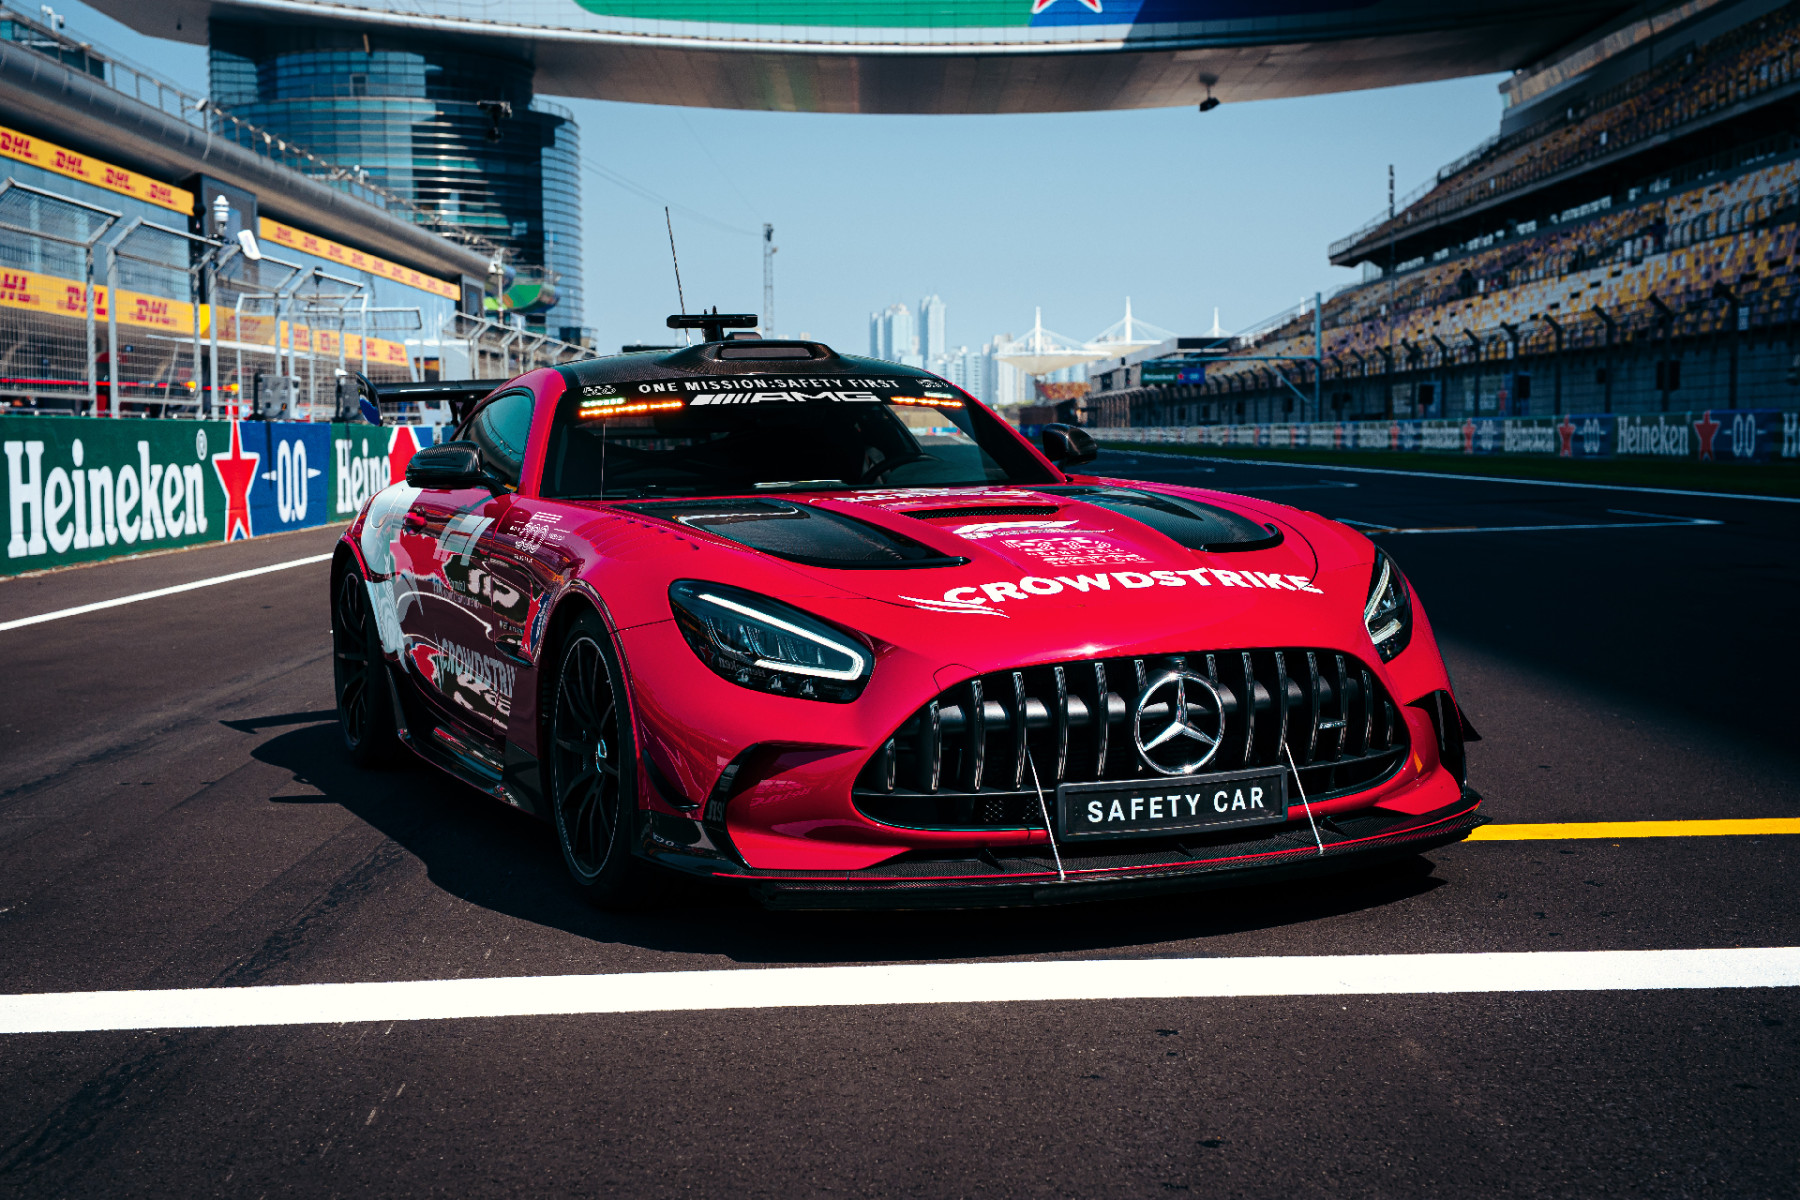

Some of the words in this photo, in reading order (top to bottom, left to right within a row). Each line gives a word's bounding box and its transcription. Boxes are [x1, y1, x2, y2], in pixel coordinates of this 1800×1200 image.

[55, 151, 85, 175] DHL
[105, 168, 131, 190] DHL
[638, 383, 678, 394] ONE
[847, 379, 900, 388] FIRST
[748, 391, 882, 402] AMG
[1617, 415, 1689, 456] Heineken
[4, 438, 208, 558] Heineken
[944, 567, 1324, 606] CROWDSTRIKE
[1087, 794, 1200, 823] SAFETY
[1213, 787, 1265, 813] CAR
